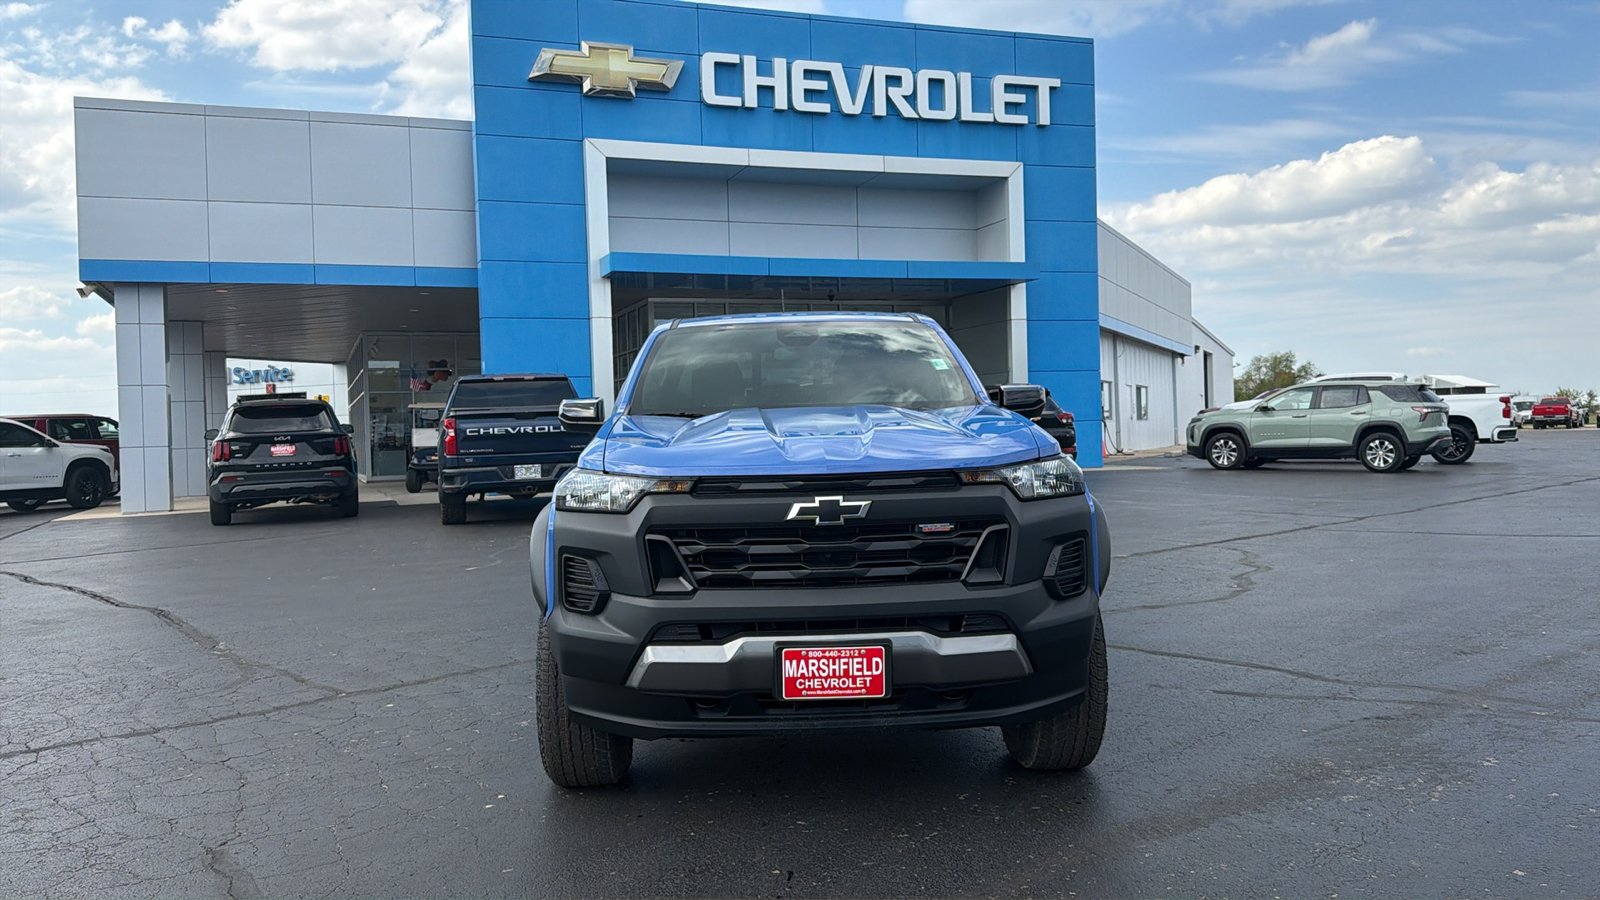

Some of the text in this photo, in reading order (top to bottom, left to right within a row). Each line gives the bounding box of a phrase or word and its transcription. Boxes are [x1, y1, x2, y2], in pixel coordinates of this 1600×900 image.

[700, 51, 1061, 127] CHEVROLET
[232, 364, 291, 384] Service
[466, 425, 567, 436] CHEVROL
[785, 657, 883, 677] MARSHFIELD
[796, 677, 872, 689] CHEVROLET
